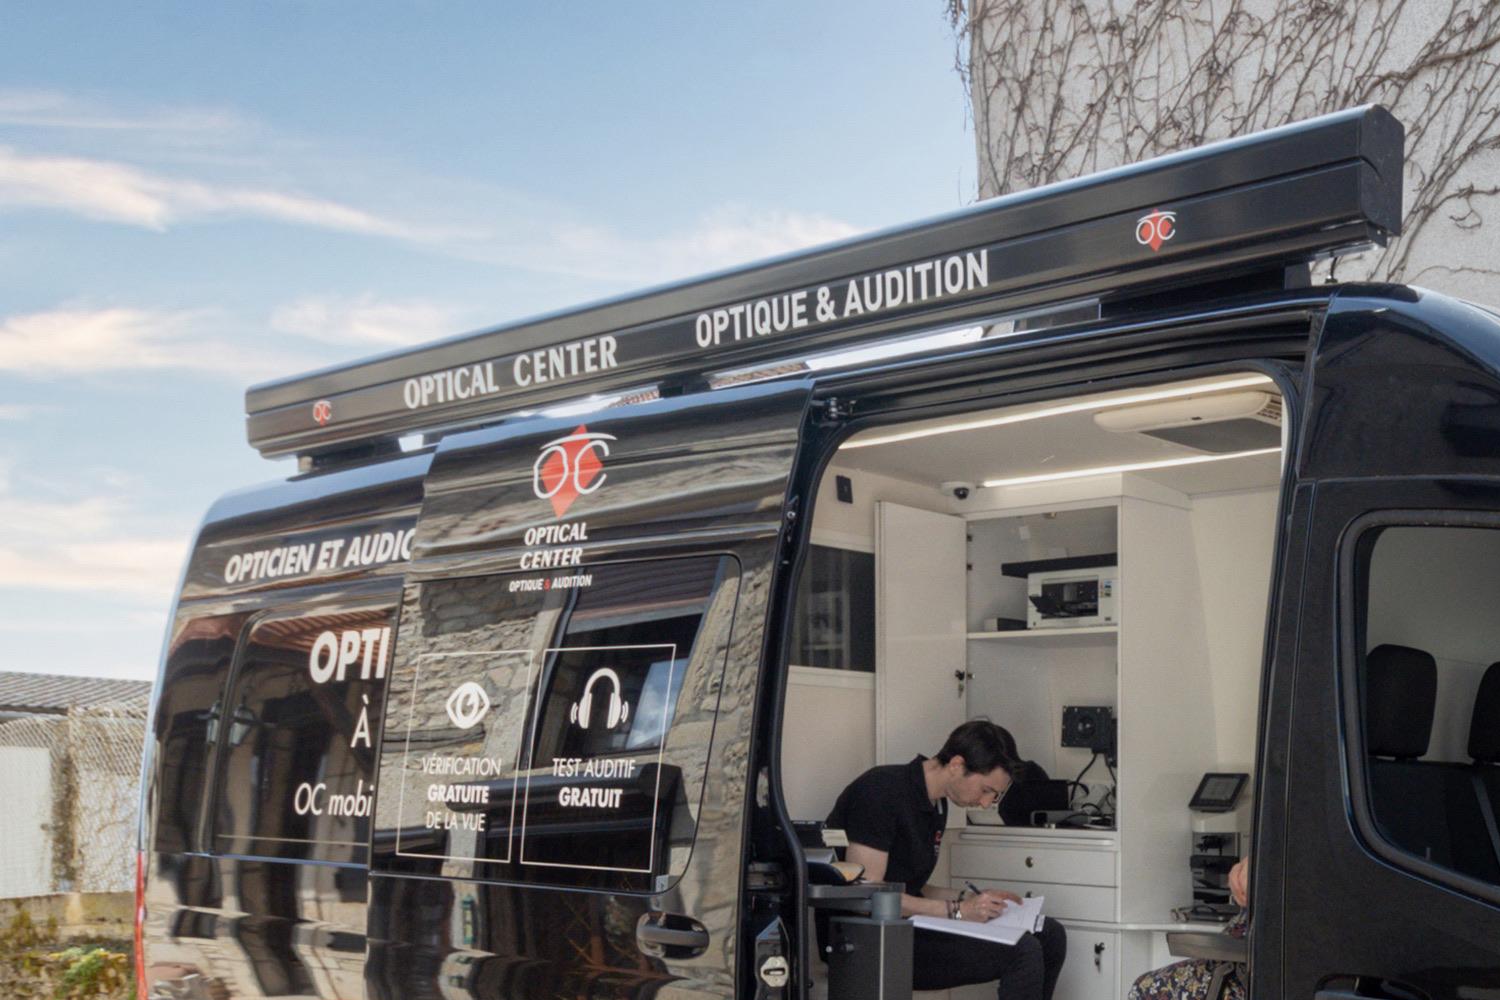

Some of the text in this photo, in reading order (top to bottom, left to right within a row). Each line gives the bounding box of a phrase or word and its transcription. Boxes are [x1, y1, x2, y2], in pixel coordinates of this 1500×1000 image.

[695, 249, 989, 348] OPTIQUE & AUDITION
[404, 335, 618, 409] OPTICAL CENTER
[524, 522, 588, 546] OPTICAL
[224, 543, 316, 584] OPTICIEN
[316, 538, 345, 571] ET
[519, 547, 583, 570] CENTER
[508, 578, 544, 593] OPTIQUE
[551, 574, 593, 589] AUDITION
[309, 627, 391, 684] OPTI
[350, 693, 371, 748] À
[421, 753, 502, 776] VÉRIFICATION
[552, 757, 636, 779] TEST AUDITIF
[294, 782, 326, 816] OC
[427, 784, 490, 804] GRATUITE
[558, 786, 624, 809] GRATUIT
[426, 811, 486, 832] DE LA VUE
